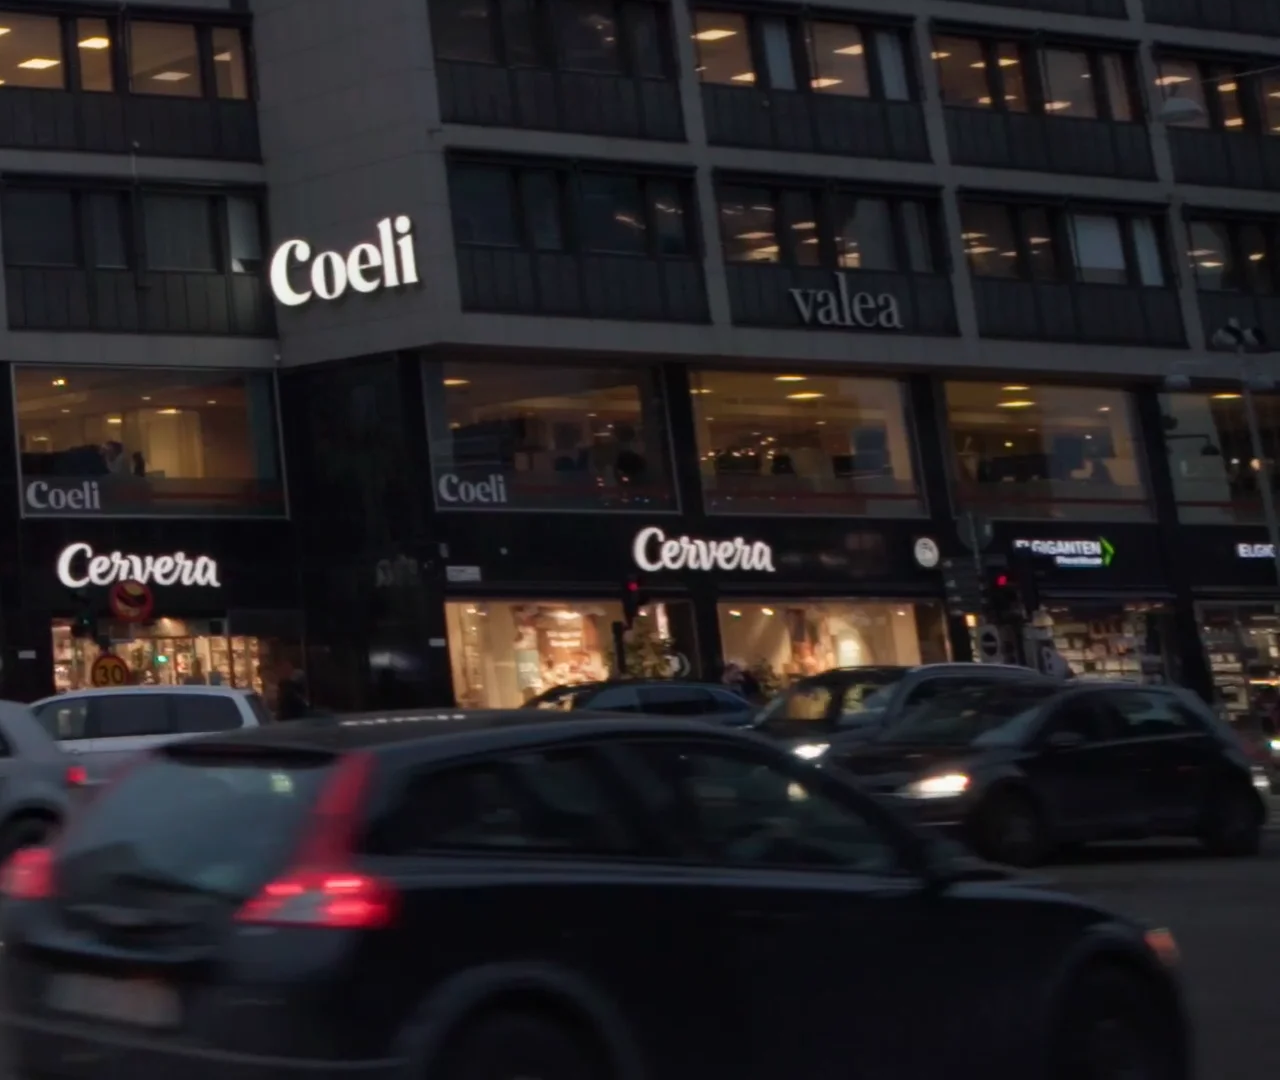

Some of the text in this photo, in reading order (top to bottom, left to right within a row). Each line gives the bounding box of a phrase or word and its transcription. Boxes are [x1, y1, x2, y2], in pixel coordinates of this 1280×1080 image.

[270, 215, 419, 306] Coeli
[788, 271, 904, 329] valea
[26, 480, 101, 510] Coeli
[439, 473, 507, 503] Coeli
[57, 542, 221, 588] Cervera
[633, 526, 776, 573] Cervera
[99, 664, 125, 685] 30
